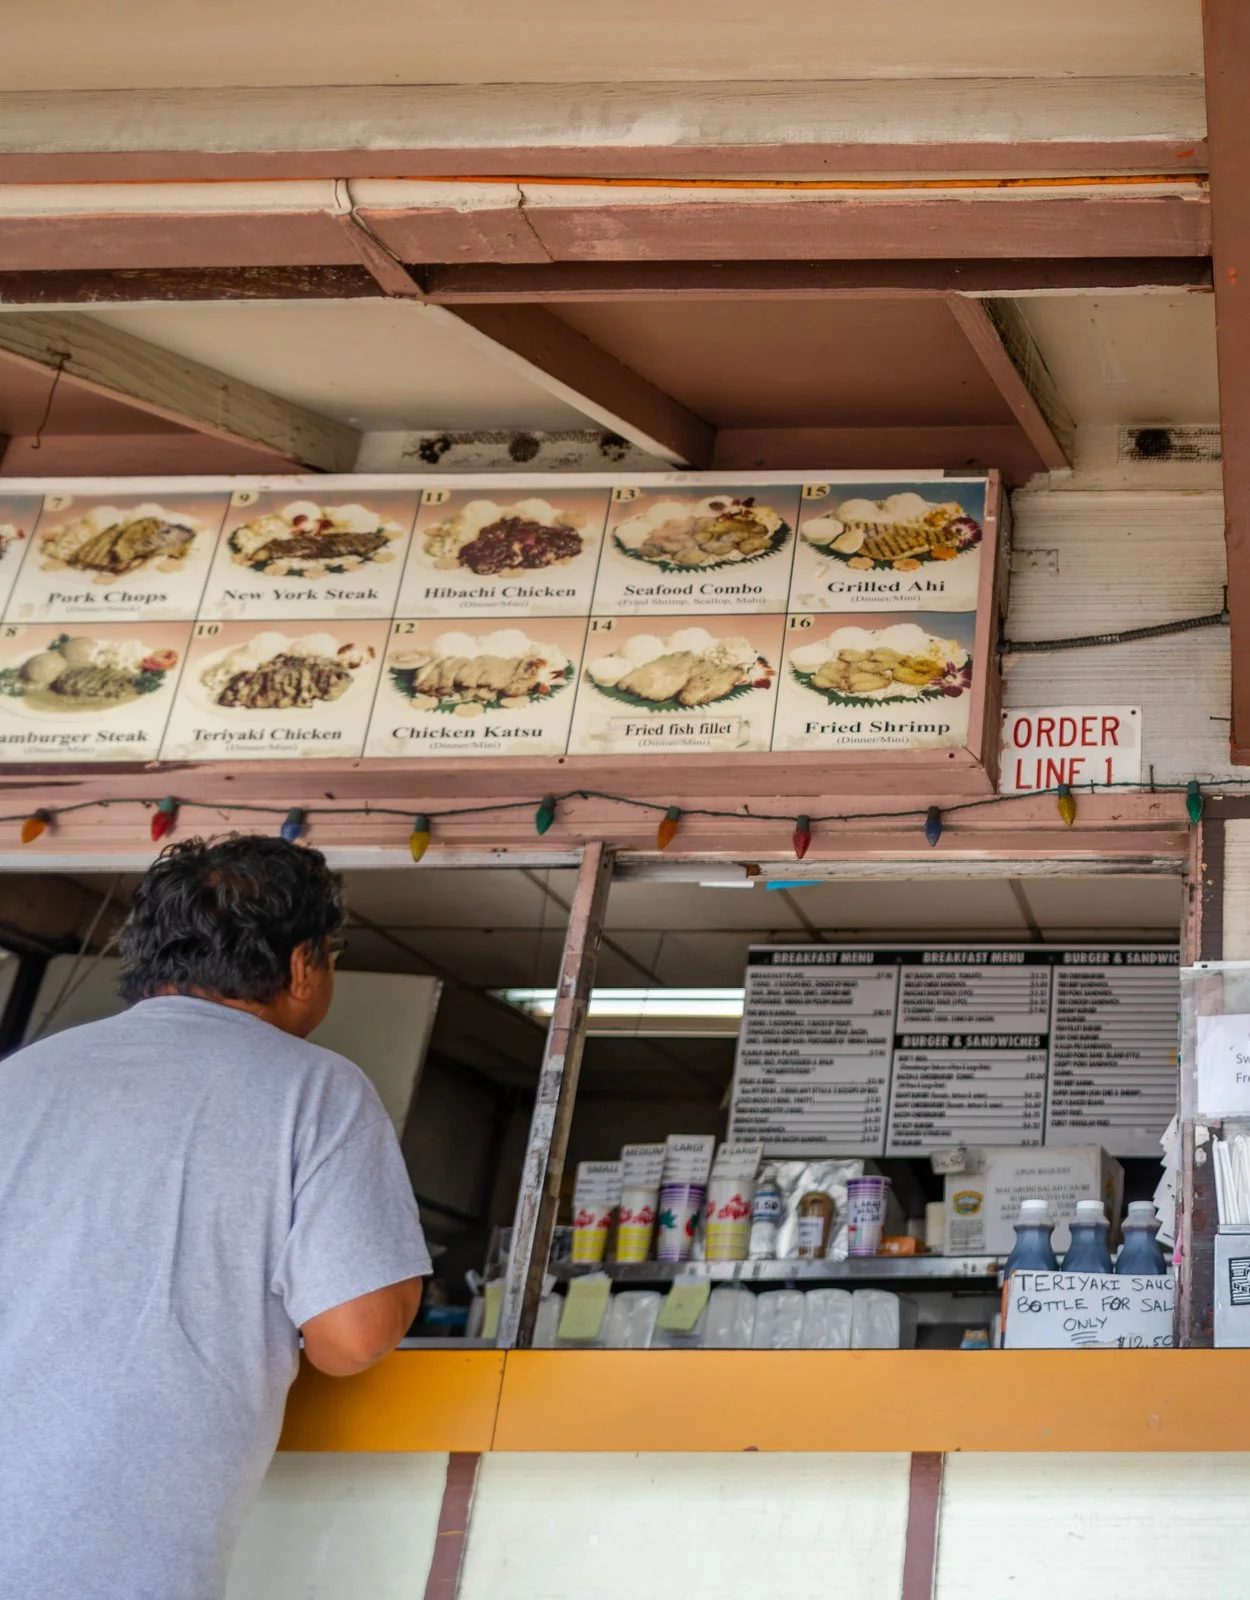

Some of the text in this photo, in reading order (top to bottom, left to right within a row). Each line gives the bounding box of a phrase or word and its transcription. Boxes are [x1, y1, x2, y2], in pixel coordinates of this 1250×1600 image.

[423, 491, 444, 502] 11
[614, 488, 637, 500] 13
[803, 485, 828, 497] 15
[424, 586, 577, 598] Hibachi Chicken
[624, 583, 763, 596] Seafood Combo
[827, 580, 946, 593] Grilled Ahi
[49, 591, 168, 605] Pork Chops
[223, 588, 379, 600] New York Steak
[393, 623, 415, 634] 12
[591, 620, 613, 631] 14
[787, 616, 812, 629] 16
[6, 626, 18, 637] 8
[197, 623, 220, 635] 10
[392, 726, 543, 738] Chicken Katsu
[625, 722, 732, 736] Fried fish fillet
[805, 721, 951, 736] Fried Shrimp
[1013, 716, 1120, 748] ORDER
[96, 730, 148, 742] Steak
[193, 728, 342, 743] Teriyaki Chicken
[1015, 756, 1113, 790] LINE 1
[772, 952, 874, 964] BREAKFAST MENU
[923, 952, 1025, 963] BREAKFAST MENU
[1064, 952, 1110, 963] BURGER
[1113, 952, 1122, 963] &
[903, 1035, 1041, 1047] BURGER & SANDWICHES
[1015, 1273, 1120, 1292] TERIYAKI
[1017, 1296, 1088, 1313] BOTTLE
[1102, 1296, 1131, 1312] FOR
[1063, 1317, 1108, 1332] ONLY
